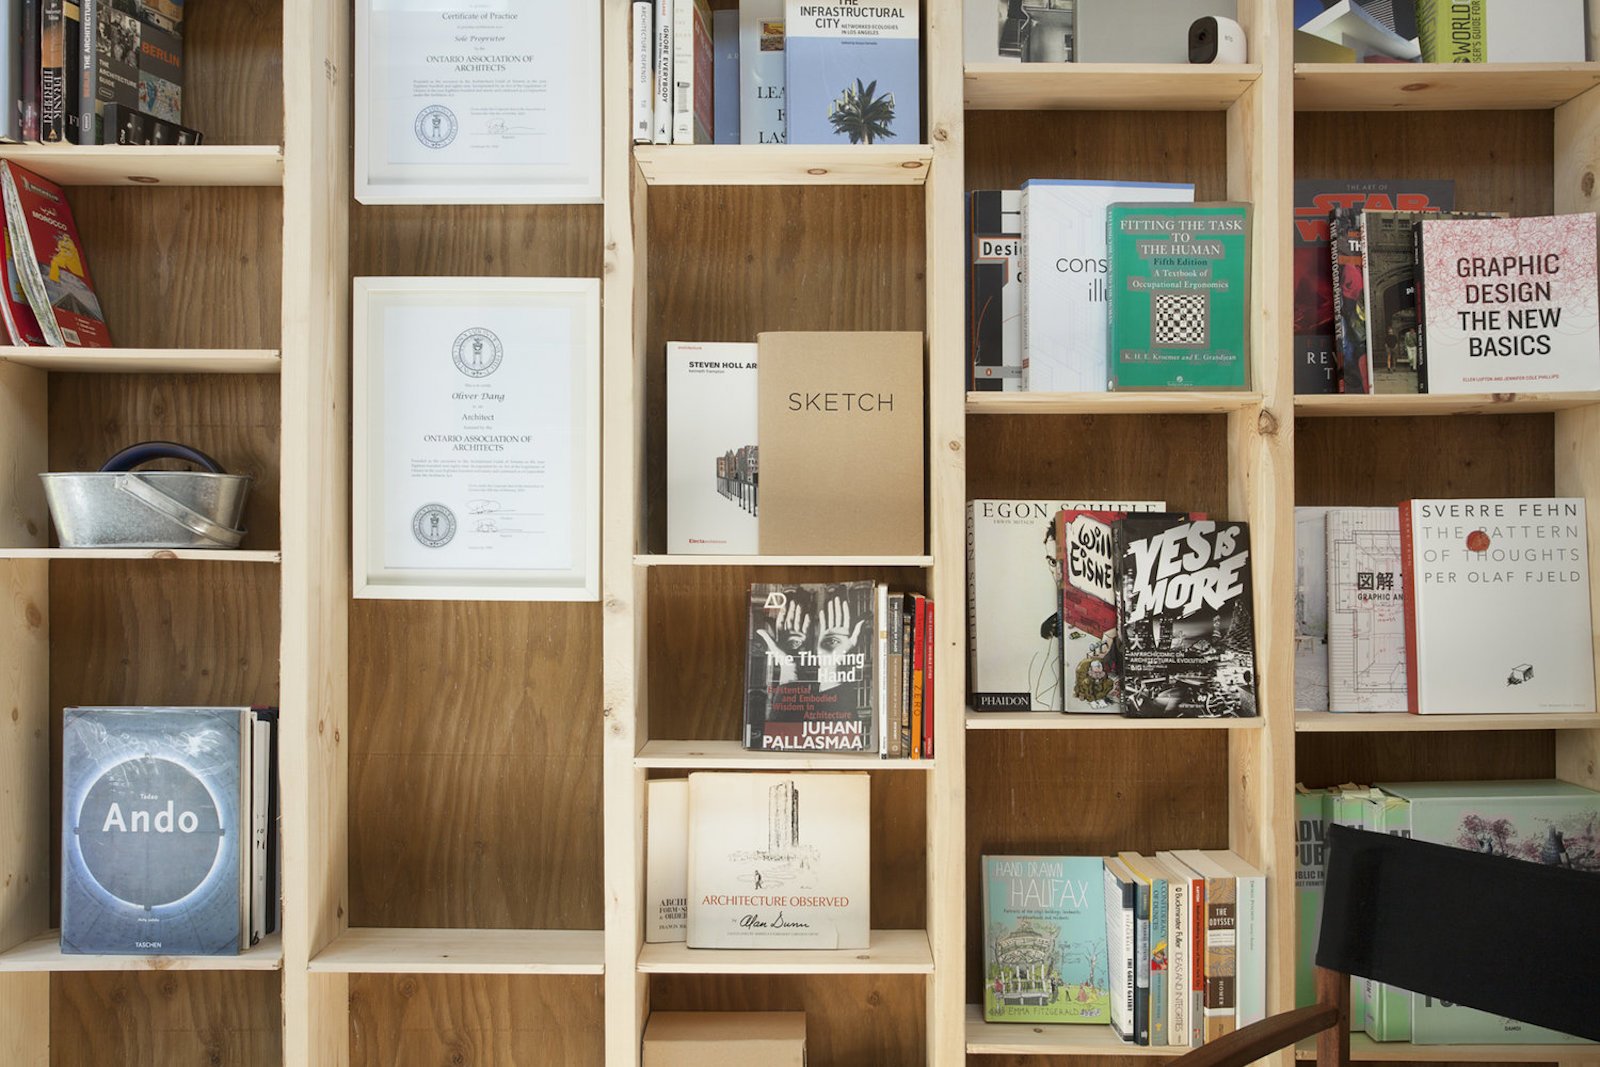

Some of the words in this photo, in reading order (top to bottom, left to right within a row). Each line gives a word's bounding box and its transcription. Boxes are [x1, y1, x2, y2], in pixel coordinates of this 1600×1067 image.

[800, 6, 905, 18] INFRASTRUCTURAL
[1472, 0, 1482, 15] FOR
[442, 12, 479, 20] Certificate
[480, 12, 488, 20] of
[489, 12, 518, 20] Practice
[815, 18, 840, 29] CITY
[1472, 16, 1482, 40] GUIDE
[454, 35, 468, 43] Sole
[470, 35, 506, 44] Proprietor
[140, 42, 180, 68] BERLIN
[426, 56, 464, 64] ONTARIO
[466, 56, 520, 64] ASSOCIATION
[522, 56, 534, 64] OF
[99, 58, 110, 69] THE
[454, 64, 506, 72] ARCHITECTS
[99, 68, 138, 89] ARCHITECTURE
[99, 76, 115, 88] GUIDE
[43, 70, 54, 125] HERBERT
[54, 77, 62, 119] FRANK
[1295, 193, 1441, 216] STAR
[32, 211, 68, 232] MOROCCO
[1120, 220, 1174, 230] FITTING
[1178, 220, 1206, 230] THE
[1208, 220, 1242, 230] TASK
[1172, 232, 1190, 242] TO
[1141, 244, 1168, 254] THE
[1171, 244, 1220, 254] HUMAN
[1154, 258, 1175, 266] Fifth
[1177, 258, 1208, 266] Edition
[1456, 254, 1560, 278] GRAPHIC
[1132, 280, 1182, 290] Occupational
[1184, 281, 1229, 290] Ergonomics
[1330, 240, 1342, 320] PHOTOGRAPHER'S
[1466, 282, 1551, 304] DESIGN
[1457, 310, 1501, 331] THE
[1508, 308, 1561, 330] NEW
[1334, 322, 1342, 341] EYE
[1470, 334, 1551, 357] BASICS
[746, 362, 758, 370] AR
[452, 392, 478, 400] Oliver
[481, 392, 505, 404] Dang
[788, 392, 894, 412] SKETCH
[424, 434, 462, 442] ONTARIO
[464, 434, 520, 442] ASSOCIATION
[520, 434, 532, 442] OF
[452, 444, 504, 452] ARCHITECTS
[983, 502, 1048, 519] EGON
[1422, 504, 1504, 518] SVERRE
[1519, 504, 1577, 516] FEHN
[1422, 526, 1463, 540] THE
[1124, 520, 1216, 593] YES
[1214, 525, 1240, 560] IS
[1424, 550, 1450, 562] OF
[1464, 548, 1580, 562] THOUGHTS
[1424, 572, 1457, 583] PER
[1468, 572, 1515, 583] OLAF
[1526, 571, 1580, 582] FJELD
[1124, 550, 1249, 625] MORE
[764, 592, 786, 608] AD
[765, 652, 794, 666] The
[798, 652, 864, 670] Thinking
[818, 669, 856, 682] Hand
[768, 686, 812, 694] Existential
[782, 694, 796, 702] and
[800, 694, 838, 702] Embodied
[981, 696, 1029, 706] PHAIDON
[772, 703, 804, 711] Wisdom
[806, 703, 814, 711] in
[804, 711, 852, 719] Architecture
[802, 721, 862, 737] JUHANI
[762, 736, 864, 750] PALLASMAA
[102, 800, 199, 833] Ando
[994, 862, 1023, 877] HAND
[1028, 862, 1064, 878] DRAWN
[1011, 878, 1088, 909] HALIFAX
[702, 895, 787, 906] ARCHITECTURE
[790, 896, 850, 908] OBSERVED
[1174, 893, 1184, 930] Buckminster
[1216, 908, 1226, 916] THE
[740, 914, 768, 930] Alan
[770, 911, 810, 928] Dunn
[1209, 917, 1234, 926] ODYSSEY
[1174, 931, 1184, 949] Fuller
[1174, 952, 1184, 972] IDEAS
[1174, 973, 1184, 990] AND
[1008, 1006, 1030, 1016] EMMA
[1033, 1007, 1078, 1016] FITZGERALD
[1174, 992, 1184, 1032] INTEGRITIES
